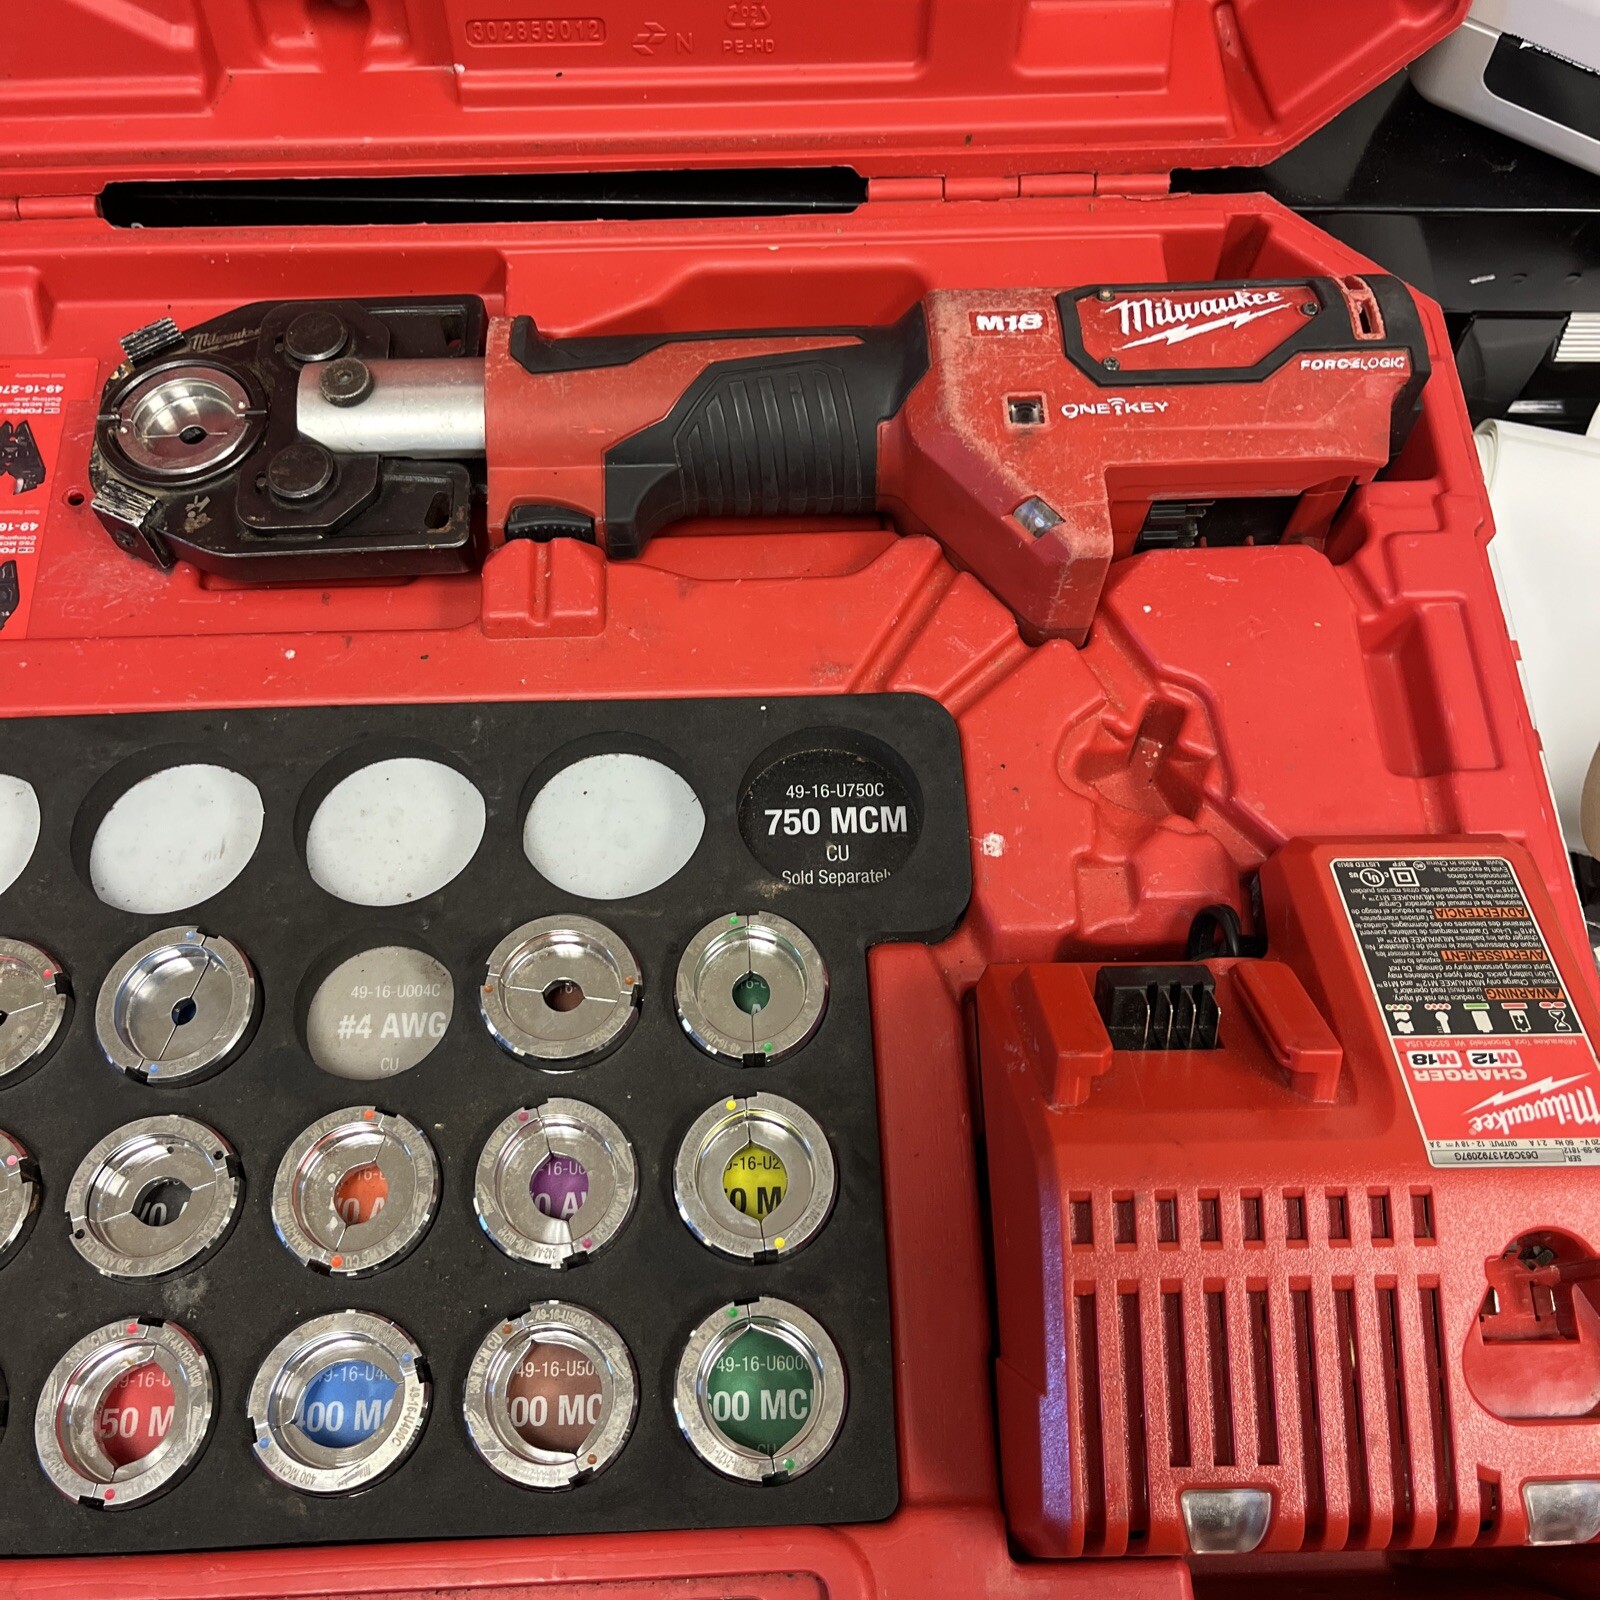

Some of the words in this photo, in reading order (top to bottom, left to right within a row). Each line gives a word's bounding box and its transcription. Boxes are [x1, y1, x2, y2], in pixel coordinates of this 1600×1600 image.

[472, 20, 601, 42] 302859012
[722, 39, 775, 53] PE-HD
[1104, 289, 1285, 335] Milwaukee
[976, 312, 1043, 331] M18
[1300, 356, 1405, 372] FORCELOGIC
[786, 783, 885, 799] 49-16-U750C
[764, 807, 821, 836] 750
[830, 805, 908, 834] MCM
[826, 845, 850, 862] CU
[781, 870, 814, 885] Sold
[818, 869, 891, 887] Separatel
[1364, 871, 1380, 883] UL
[1434, 908, 1525, 918] ADVERTENCIA
[1453, 920, 1487, 928] blessures
[1410, 935, 1455, 943] MILWAUKEE
[1512, 933, 1539, 941] charger
[1415, 956, 1441, 964] expose
[1421, 950, 1439, 958] Pour
[1443, 950, 1545, 961] AVERTISSEMENT
[32, 953, 48, 969] CU
[1407, 957, 1415, 965] to
[1473, 963, 1504, 971] personal
[1504, 962, 1532, 970] causing
[1403, 972, 1434, 980] batteries
[1435, 972, 1443, 980] of
[1443, 970, 1463, 979] types
[1464, 971, 1484, 979] Other
[1509, 970, 1533, 978] battery
[1439, 979, 1486, 987] MILWAUKEE
[1486, 978, 1502, 986] only
[1502, 977, 1529, 986] Charge
[350, 983, 441, 999] 49-16-U004C
[1485, 988, 1550, 1000] WARNING
[337, 1014, 372, 1040] #4
[380, 1011, 447, 1039] AWG
[1533, 1038, 1577, 1046] Milwaukee
[380, 1057, 400, 1071] CU
[1411, 1053, 1458, 1065] M18
[1471, 1052, 1518, 1065] M12
[1412, 1068, 1528, 1081] CHARGER
[1467, 1085, 1600, 1135] Milwaukee
[500, 1116, 518, 1134] CU
[1460, 1140, 1469, 1148] 18
[1528, 1139, 1534, 1147] A
[1453, 1150, 1539, 1161] D63C9213792097G
[1564, 1154, 1582, 1162] SER.
[78, 1236, 97, 1255] CU
[344, 1253, 359, 1267] CU
[79, 1329, 108, 1354] CM
[108, 1322, 124, 1338] CU
[483, 1329, 503, 1351] CU
[115, 1371, 171, 1388] 9-16-U
[317, 1365, 391, 1383] 9-16-U4
[760, 1388, 814, 1421] MC
[390, 1385, 419, 1448] 49-16-U400C
[506, 1395, 548, 1427] 00
